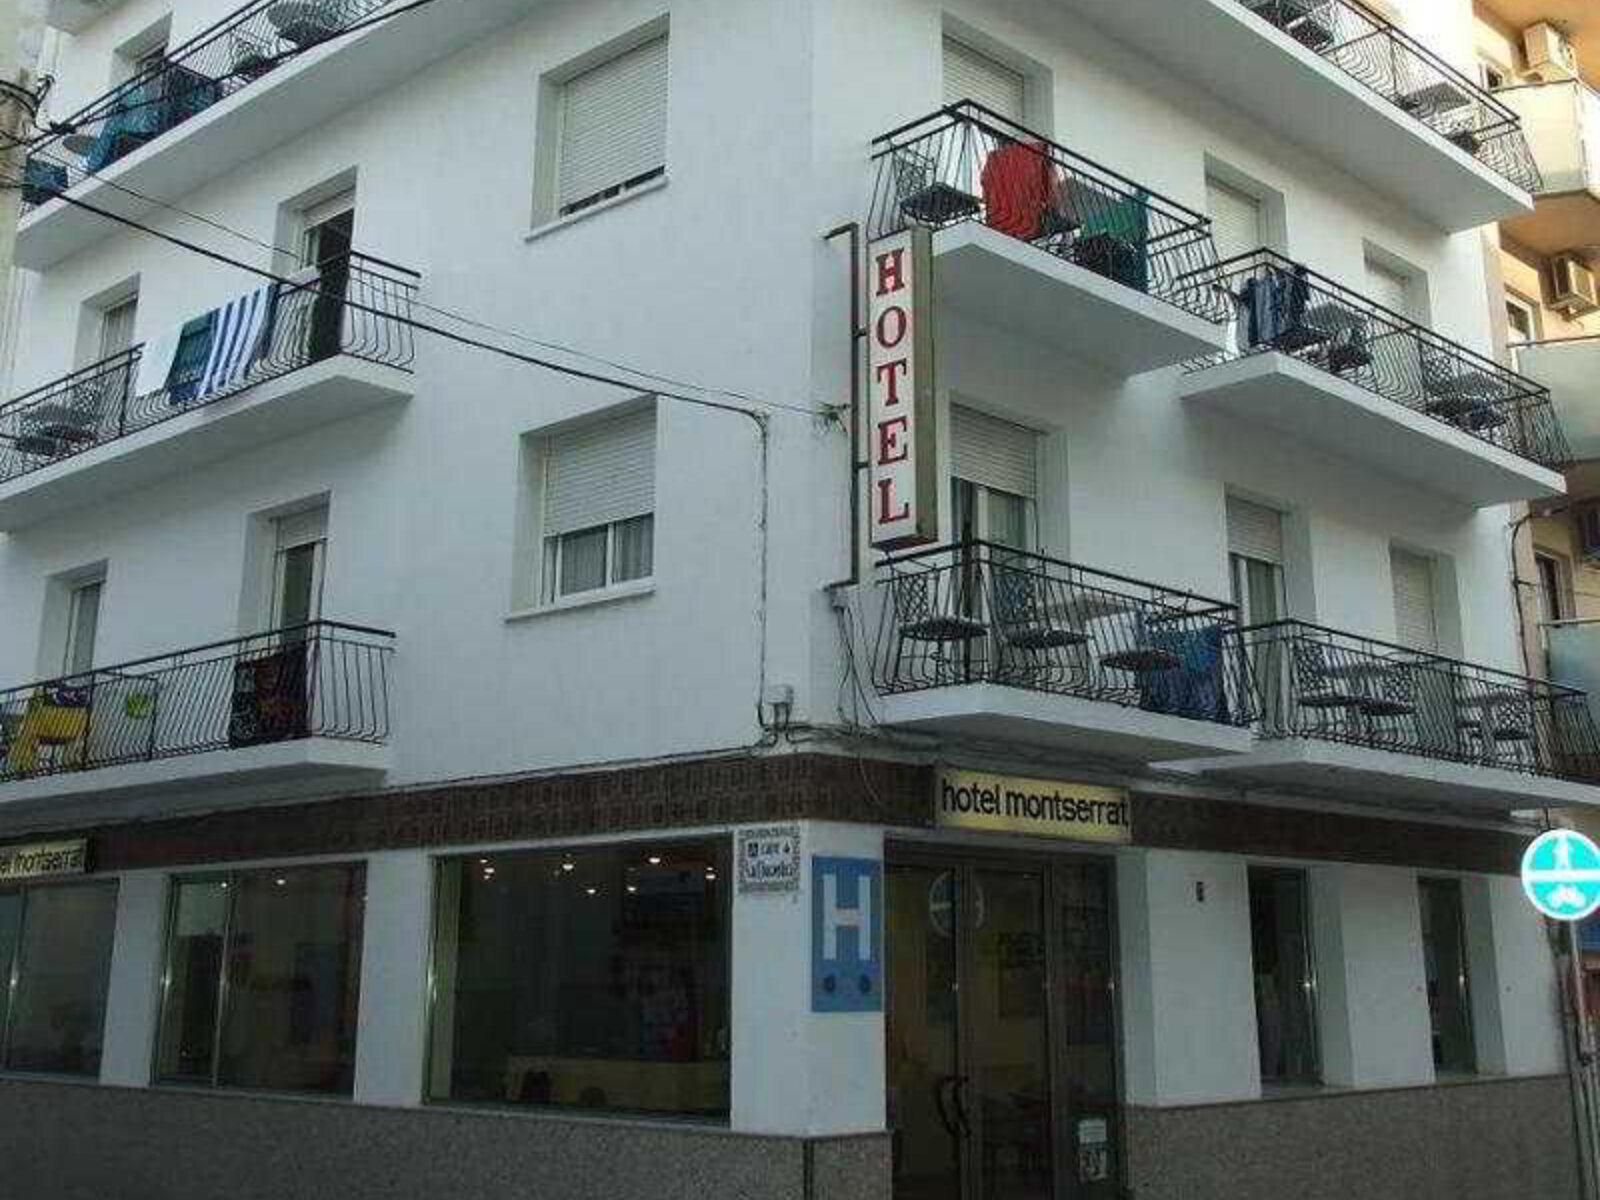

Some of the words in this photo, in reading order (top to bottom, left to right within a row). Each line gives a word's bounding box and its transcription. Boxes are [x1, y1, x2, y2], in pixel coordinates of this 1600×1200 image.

[874, 247, 910, 525] HOTEL
[942, 778, 1001, 816] hotel
[1005, 790, 1129, 827] montserrat
[822, 874, 871, 961] H
